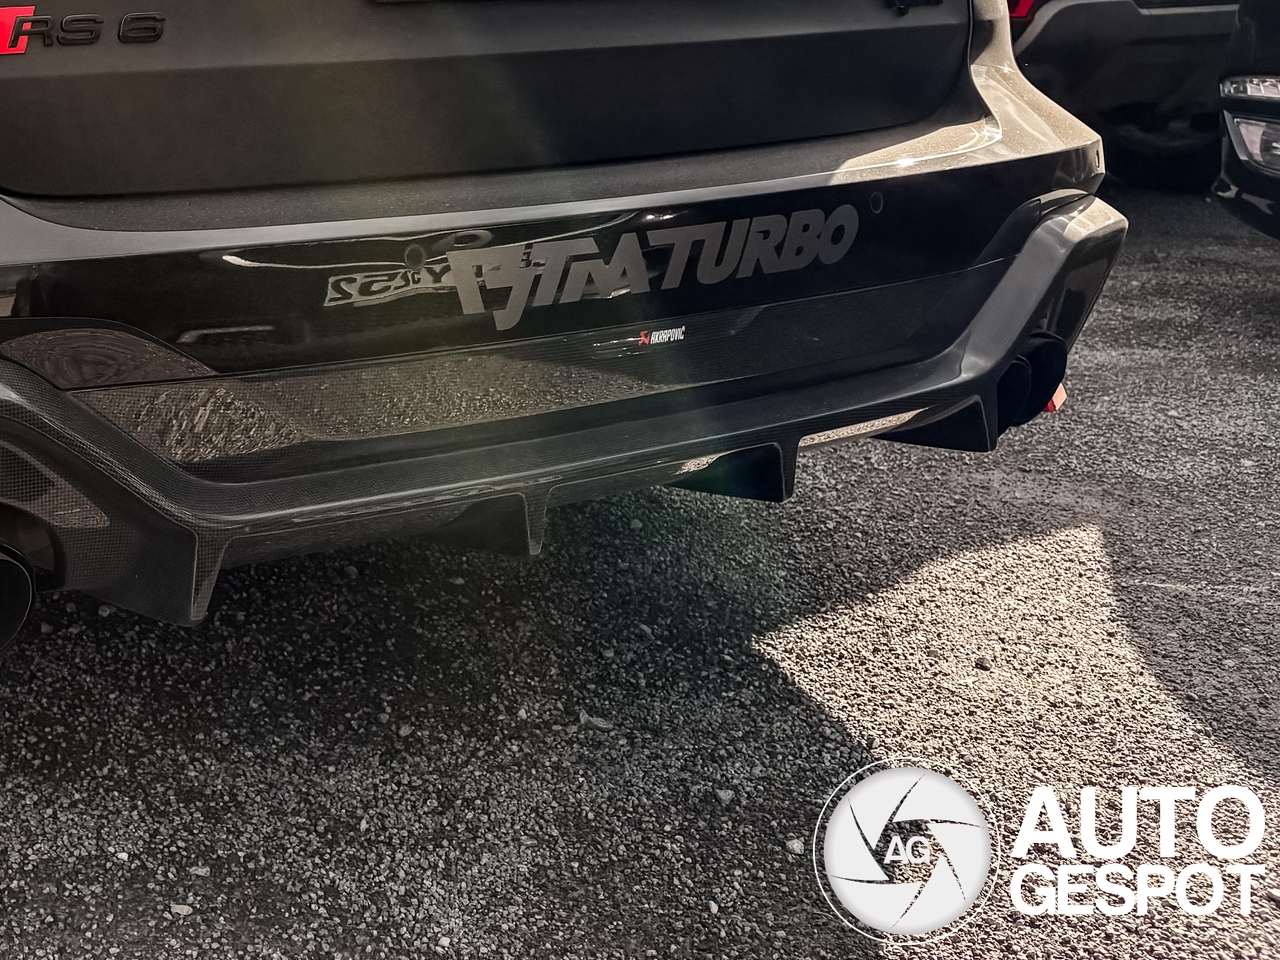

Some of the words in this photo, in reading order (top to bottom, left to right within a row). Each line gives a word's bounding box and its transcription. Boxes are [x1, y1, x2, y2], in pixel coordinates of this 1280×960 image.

[7, 13, 104, 48] RS
[117, 11, 166, 44] 6
[646, 203, 859, 291] TURBO
